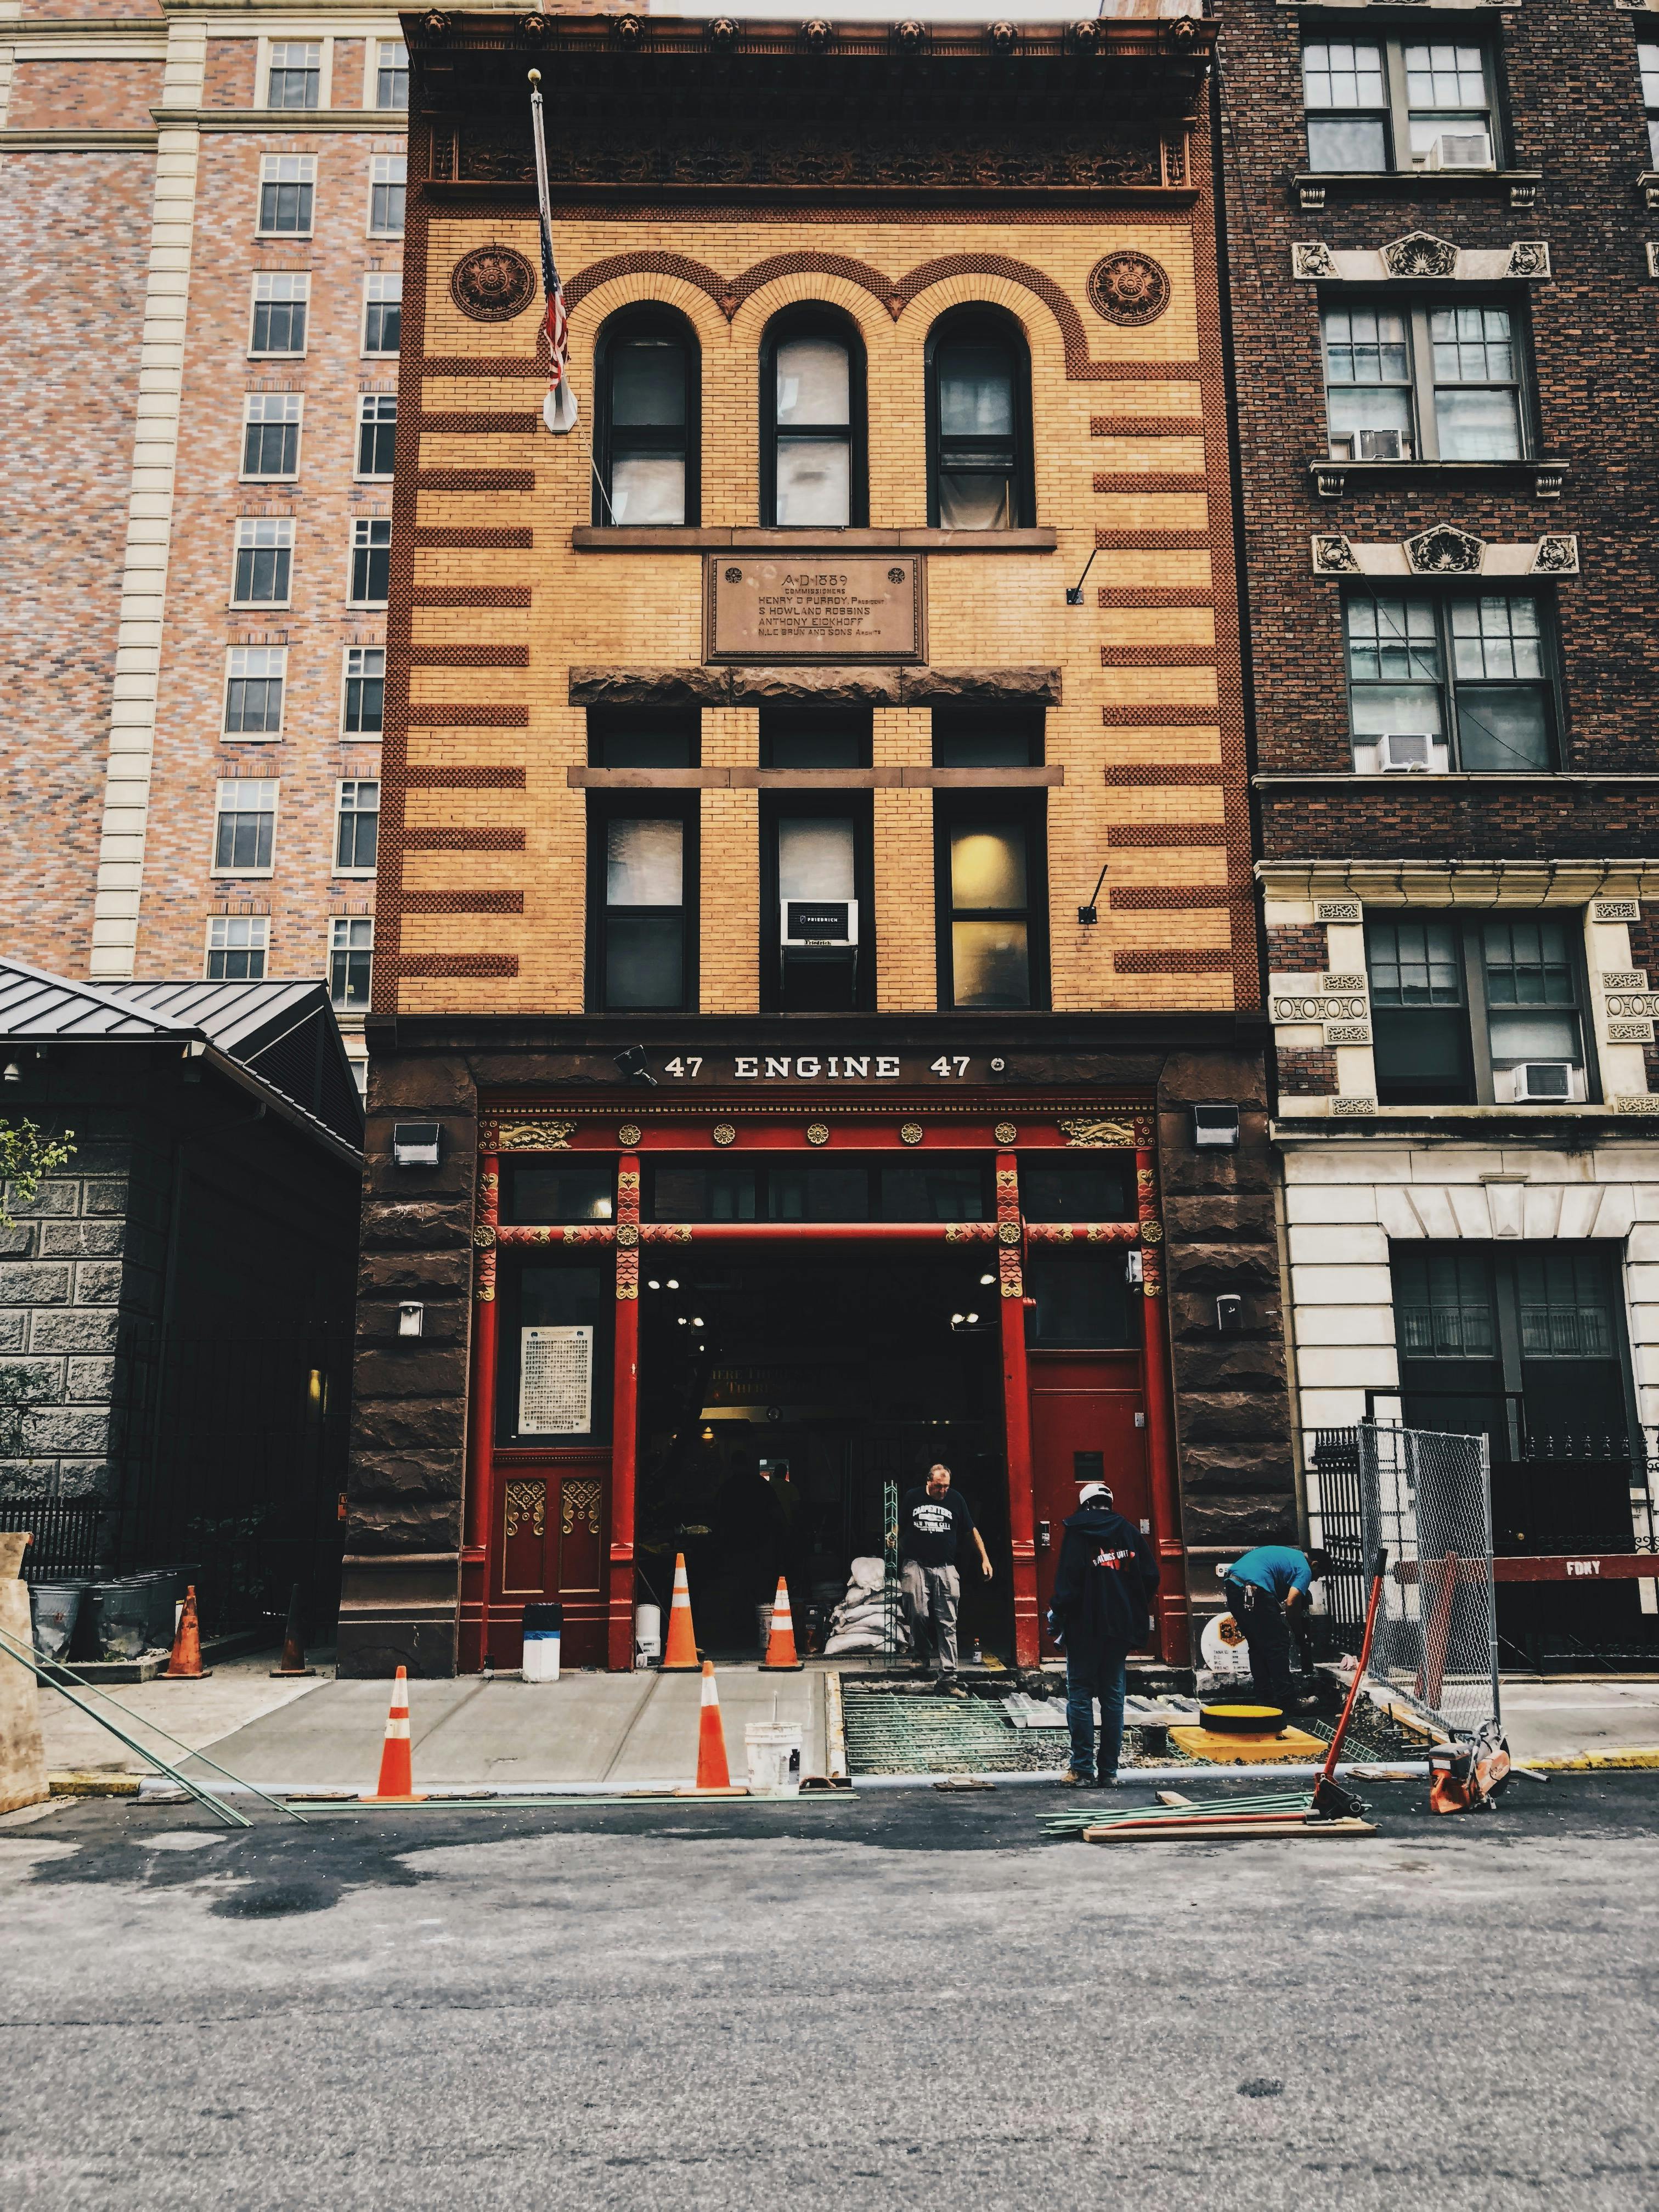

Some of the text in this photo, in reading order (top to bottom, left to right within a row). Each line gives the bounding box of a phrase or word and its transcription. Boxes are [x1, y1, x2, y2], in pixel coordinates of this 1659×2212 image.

[758, 596, 793, 605] HENRY
[769, 607, 821, 615] HOWLAND
[825, 607, 870, 615] ROBBINS
[758, 618, 864, 626] ANTHONY EICKHOFF
[665, 1056, 970, 1077] 47 ENGINE 47
[1116, 1549, 1128, 1559] UNIT
[1566, 1561, 1600, 1575] FDNY
